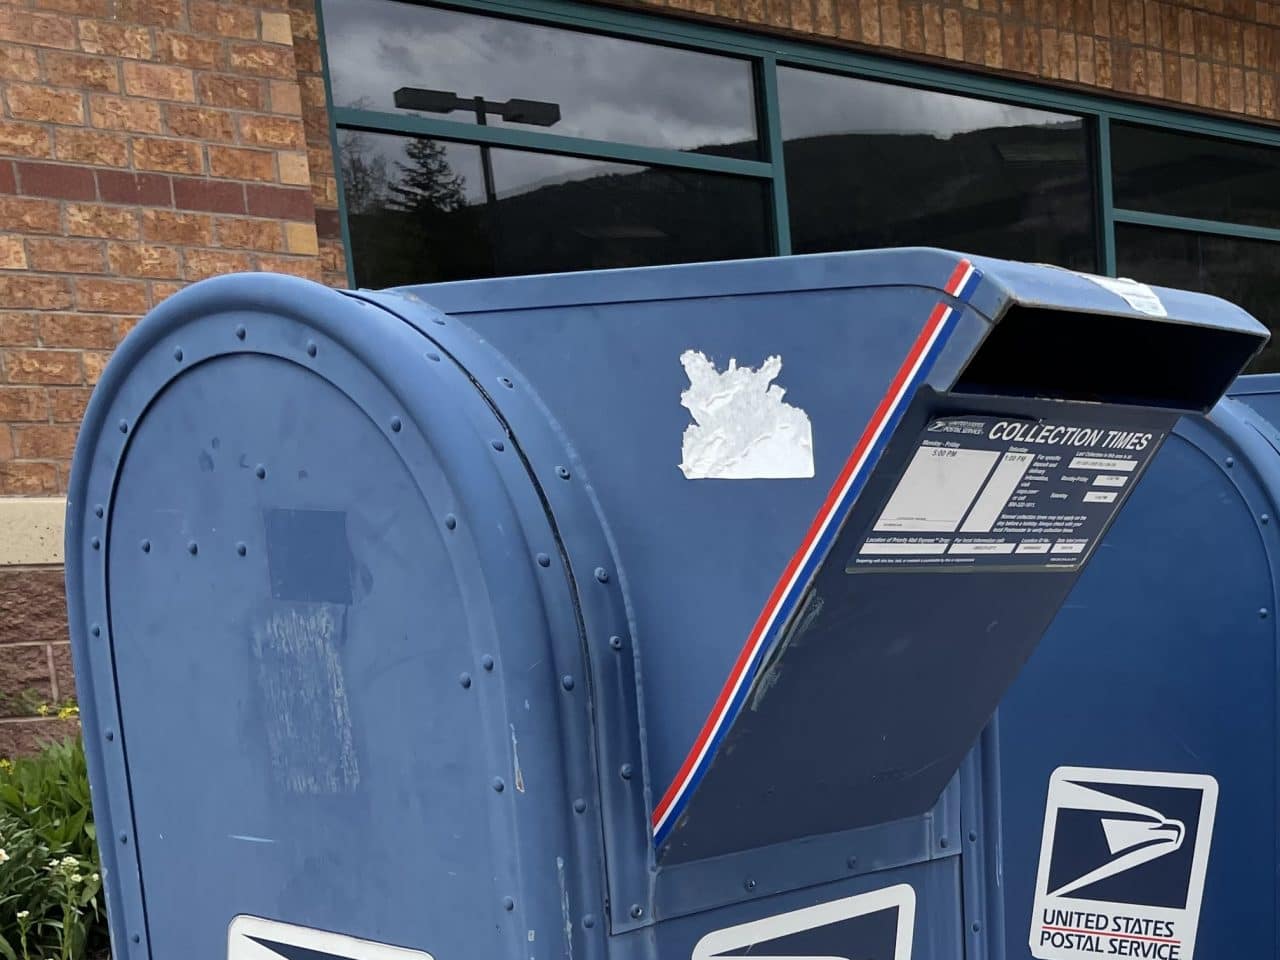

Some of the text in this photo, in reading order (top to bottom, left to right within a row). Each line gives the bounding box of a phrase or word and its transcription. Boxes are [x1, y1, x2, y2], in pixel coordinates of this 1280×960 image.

[989, 421, 1152, 450] COLLECTION TIMES
[1043, 909, 1175, 938] UNITED STATES
[1040, 931, 1104, 953] POSTAL
